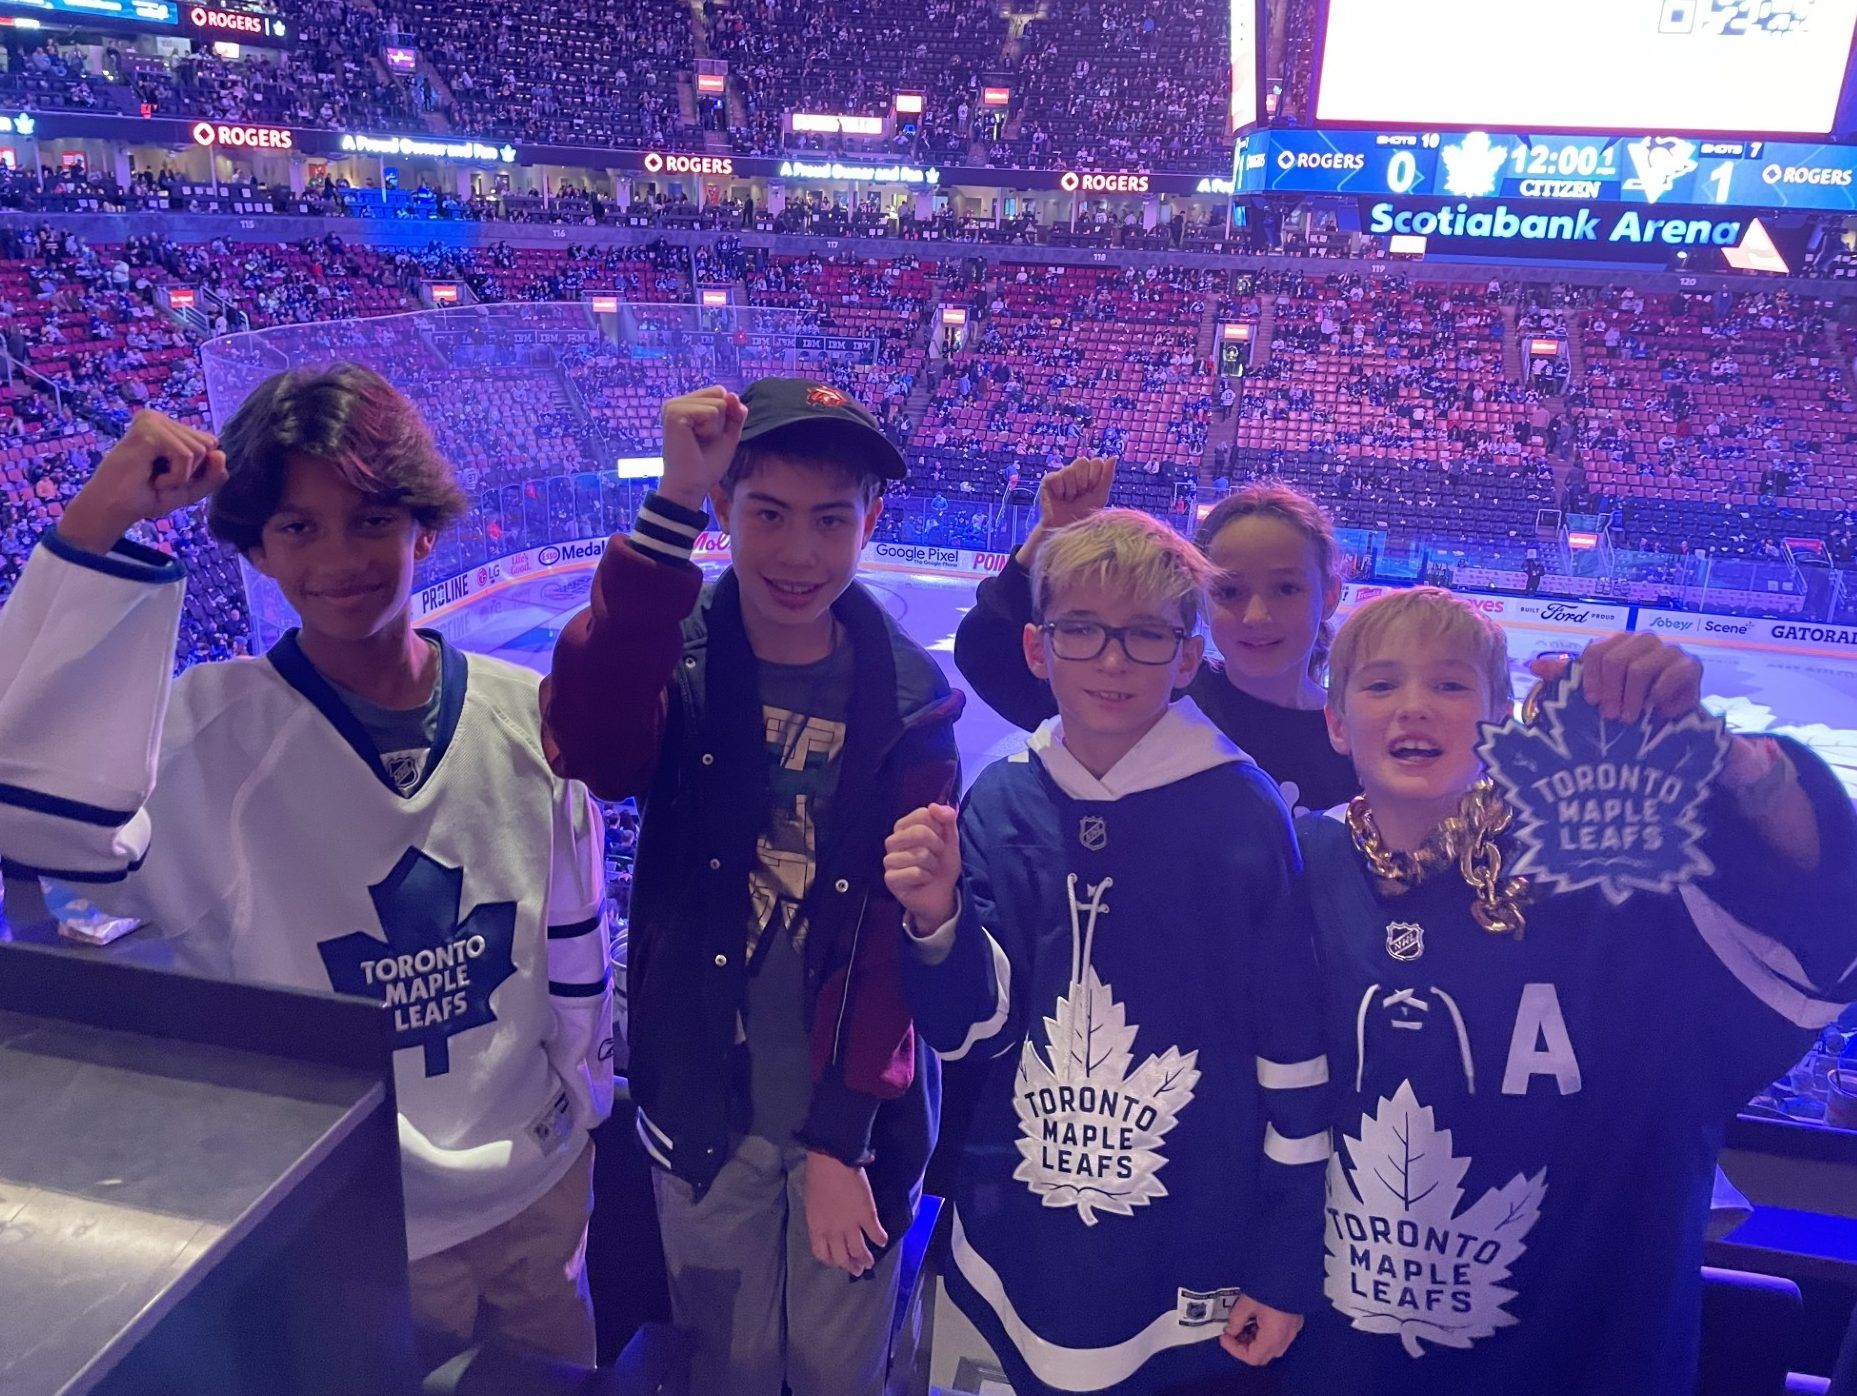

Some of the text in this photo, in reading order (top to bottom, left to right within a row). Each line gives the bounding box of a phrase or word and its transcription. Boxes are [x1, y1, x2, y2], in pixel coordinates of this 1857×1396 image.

[208, 11, 262, 33] ROGERS
[218, 126, 292, 149] ROGERS
[1298, 153, 1365, 170] ROGERS
[1511, 145, 1599, 175] 12:00
[1749, 142, 1762, 159] 7
[666, 155, 733, 175] ROGERS
[1387, 151, 1416, 193] 0
[1783, 166, 1852, 186] ROGERS
[1082, 174, 1149, 192] ROGERS
[1519, 181, 1601, 199] CITIZEN
[1710, 161, 1734, 203] 1
[240, 220, 255, 229] 115
[552, 229, 566, 238] 116
[1370, 202, 1741, 245] Scotiabank Arena
[827, 241, 839, 249] 117
[1093, 253, 1107, 261] 118
[1371, 264, 1386, 273] 119
[1680, 277, 1696, 286] 120
[803, 338, 820, 348] IBM
[828, 340, 870, 350] IBM IBM
[562, 540, 605, 561] Medal
[876, 543, 959, 563] Google Pixel
[488, 564, 500, 580] LG
[422, 573, 469, 614] PROLINE
[1520, 602, 1615, 623] BUILT Ford PROUD
[1531, 762, 1683, 804] TORONTO
[1558, 798, 1661, 824] MAPLE
[1559, 825, 1662, 851] LEAFS
[360, 934, 486, 985] TORONTO
[384, 964, 471, 1007] MAPLE
[393, 996, 468, 1033] LEAFS
[1501, 982, 1582, 1096] A
[1024, 1085, 1158, 1132] TORONTO
[1042, 1118, 1134, 1151] MAPLE
[1042, 1145, 1133, 1179] LEAFS
[1327, 1207, 1501, 1266] TORONTO
[1350, 1244, 1471, 1286] MAPLE
[1350, 1272, 1472, 1314] LEAFS
